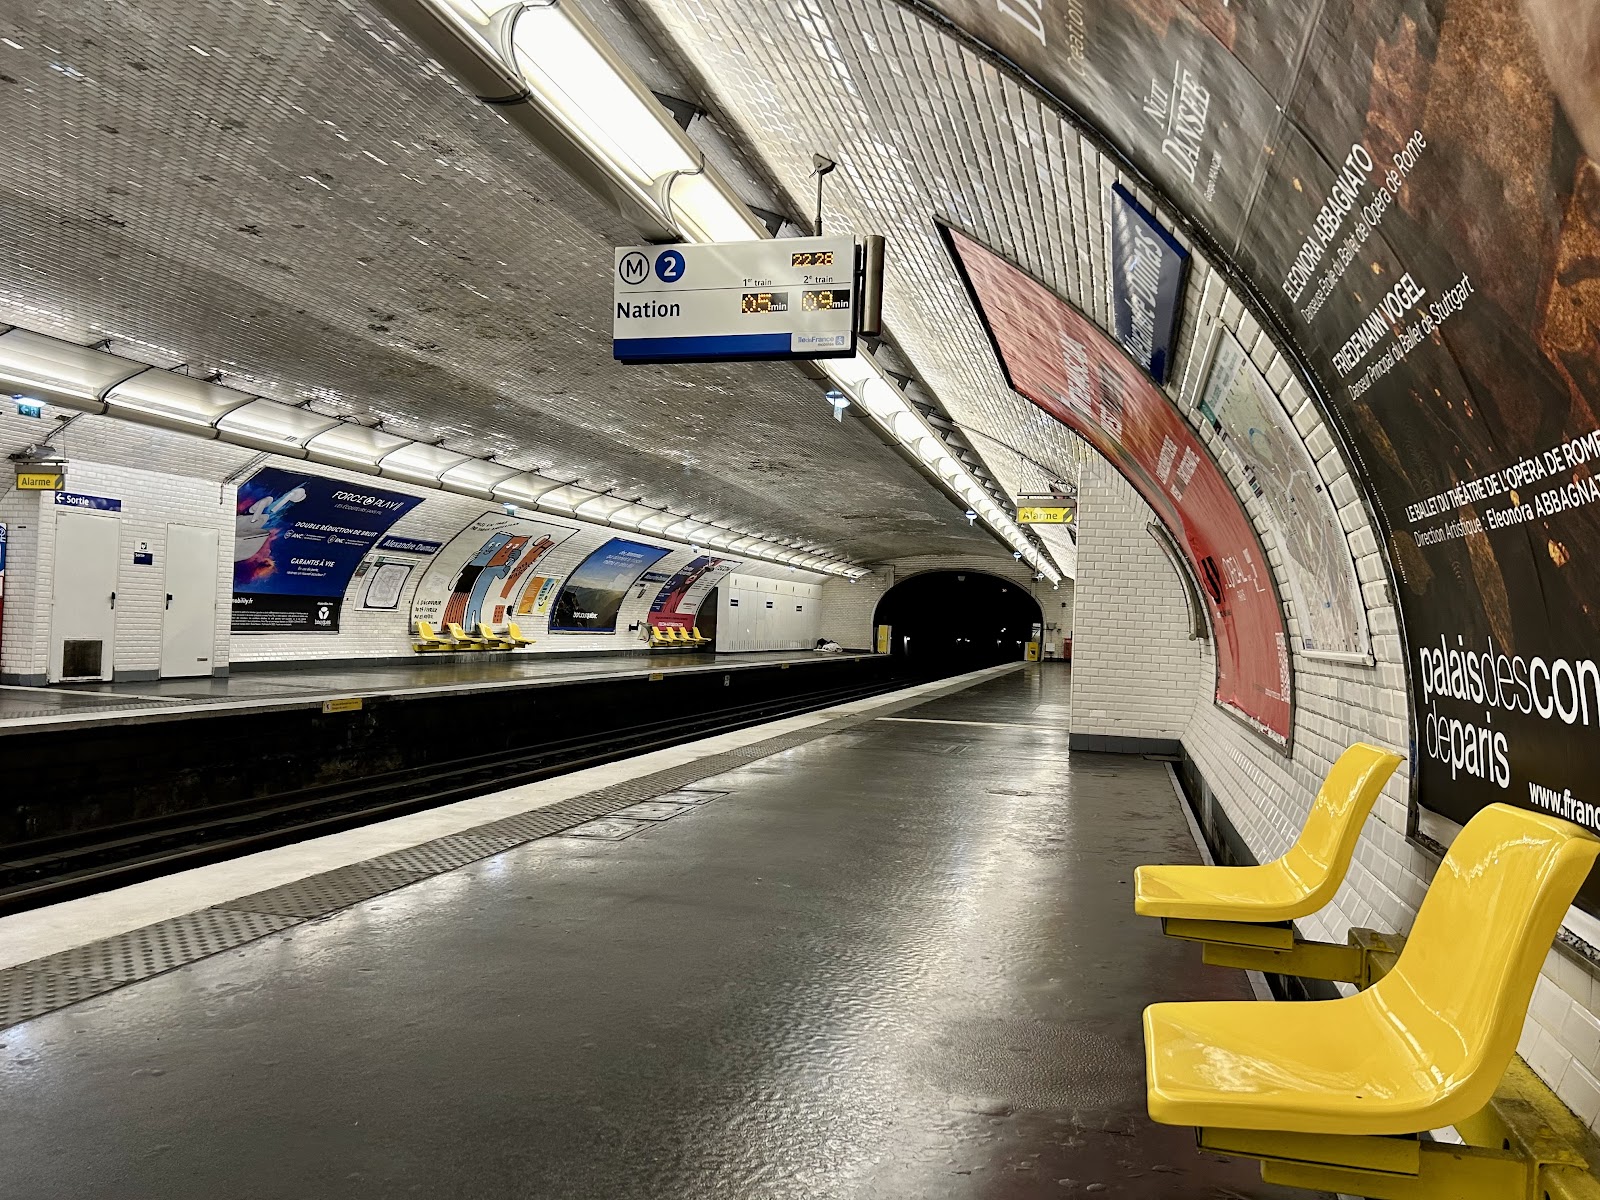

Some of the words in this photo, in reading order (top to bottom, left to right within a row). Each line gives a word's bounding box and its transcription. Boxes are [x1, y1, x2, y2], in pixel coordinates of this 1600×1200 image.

[1143, 78, 1168, 130] NUIT
[1393, 129, 1427, 179] Rome
[1386, 168, 1402, 194] de
[1362, 187, 1392, 229] l'Opéra
[1282, 236, 1324, 303] ELEONORA
[1313, 143, 1374, 250] ABBAGNATO
[1355, 220, 1370, 244] de
[1337, 231, 1362, 268] Ballet
[663, 256, 678, 277] 2
[1127, 225, 1163, 308] Dumas
[1332, 257, 1346, 278] du
[617, 302, 681, 319] Nation
[742, 293, 772, 313] 05
[771, 302, 787, 311] min
[803, 291, 833, 312] 09
[832, 300, 849, 309] min
[1300, 286, 1328, 325] Danseuse
[1124, 297, 1155, 372] Alexandre
[1331, 308, 1390, 378] FRIEDEMANN
[1380, 271, 1427, 326] VOGEL
[1347, 367, 1374, 402] Danseur
[1367, 349, 1395, 389] Principal
[1390, 340, 1403, 362] du
[1399, 325, 1425, 355] Ballet
[1420, 312, 1436, 334] de
[1429, 272, 1475, 328] Stuttgart
[21, 477, 51, 486] Alarme
[1405, 506, 1418, 523] LE
[1413, 496, 1440, 521] BALLET
[1436, 492, 1451, 515] DU
[1447, 479, 1488, 511] THÉÂTRE
[1483, 475, 1501, 497] DE
[1499, 455, 1546, 492] L'OPÉRA
[1543, 446, 1566, 476] DE
[66, 495, 90, 506] Sortie
[331, 490, 367, 503] FORCE
[1022, 511, 1058, 520] Alarme
[1413, 527, 1447, 548] Direction
[1444, 517, 1484, 541] Artistique
[1487, 503, 1534, 530] Eleonora
[1534, 473, 1600, 518] ABBAGNA
[295, 521, 321, 530] DOUBLE
[320, 524, 353, 534] RÉDUCTION
[382, 540, 416, 550] Alexandre
[414, 544, 438, 552] Dumas
[290, 557, 319, 566] GARANTIS
